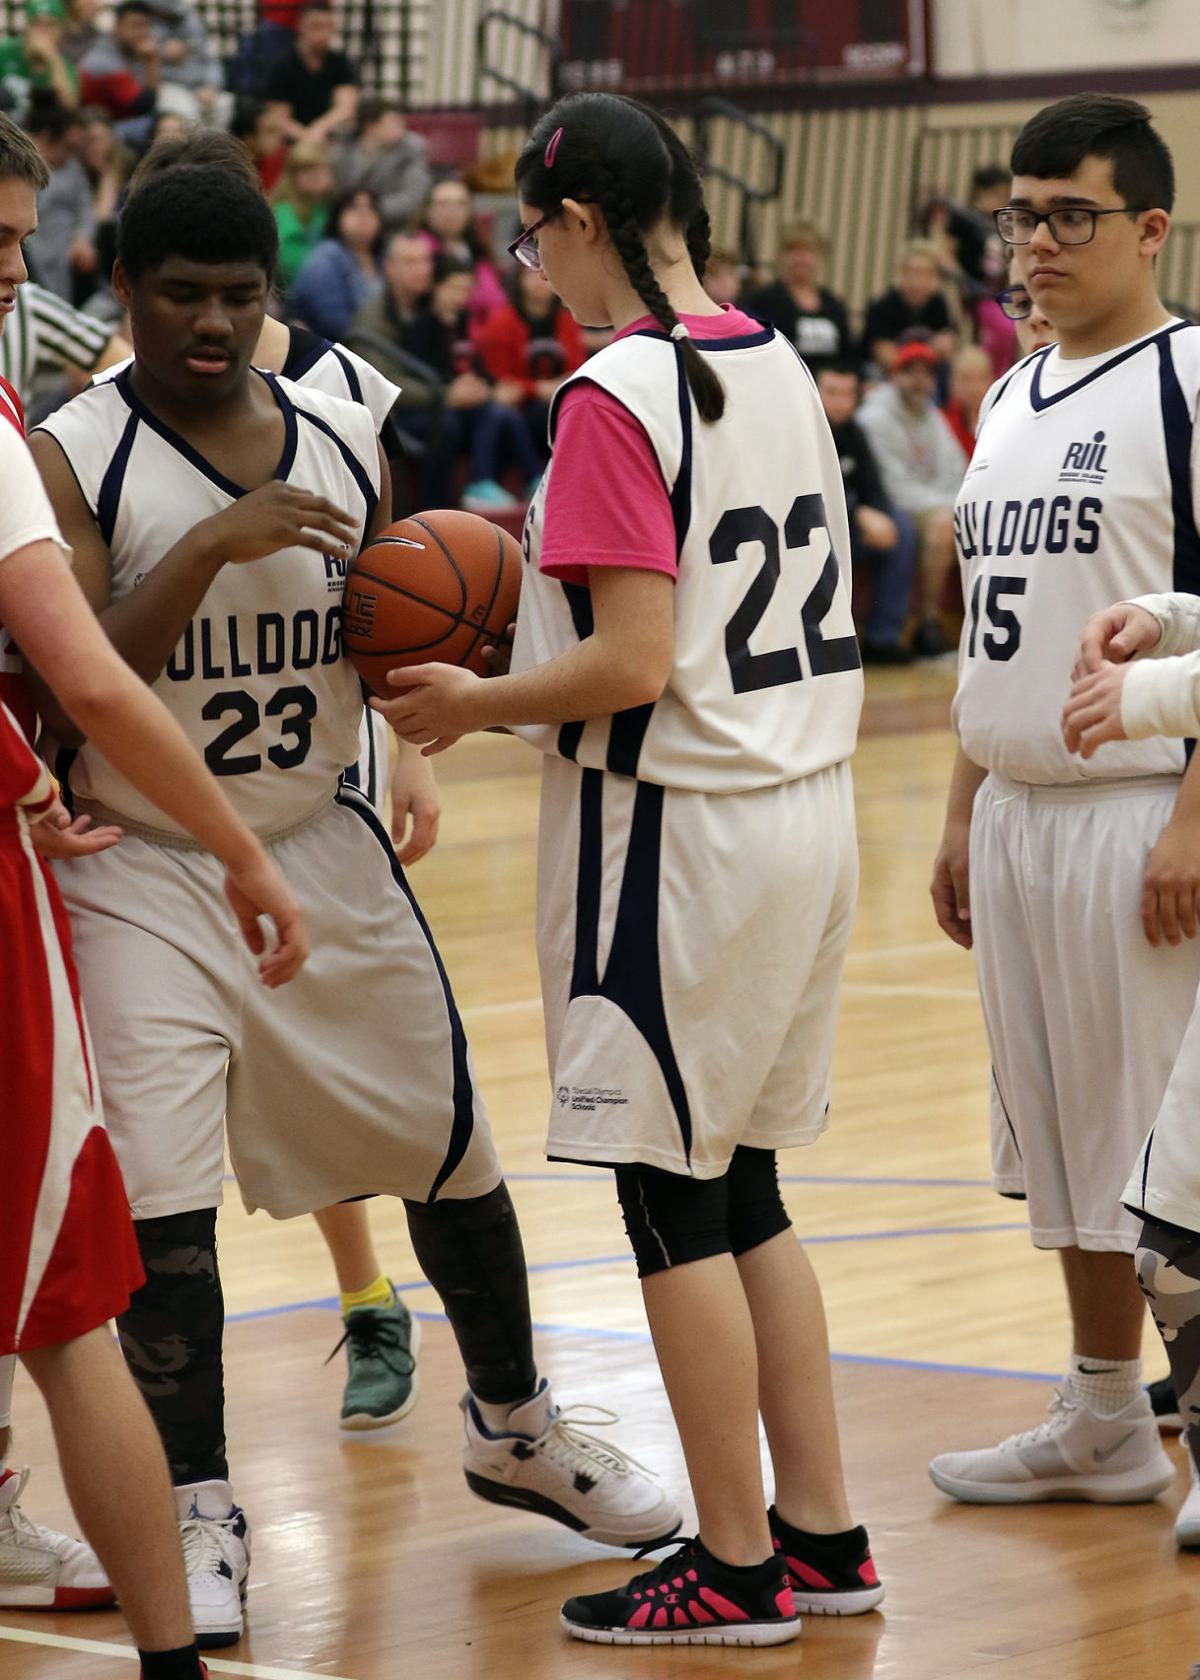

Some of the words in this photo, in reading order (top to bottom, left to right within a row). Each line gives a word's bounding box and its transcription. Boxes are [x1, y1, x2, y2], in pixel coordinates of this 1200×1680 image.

[955, 495, 1103, 559] ULLDOGS
[708, 493, 862, 694] 22
[968, 574, 1027, 662] 15
[167, 605, 343, 681] ULLDOG
[201, 684, 317, 776] 23
